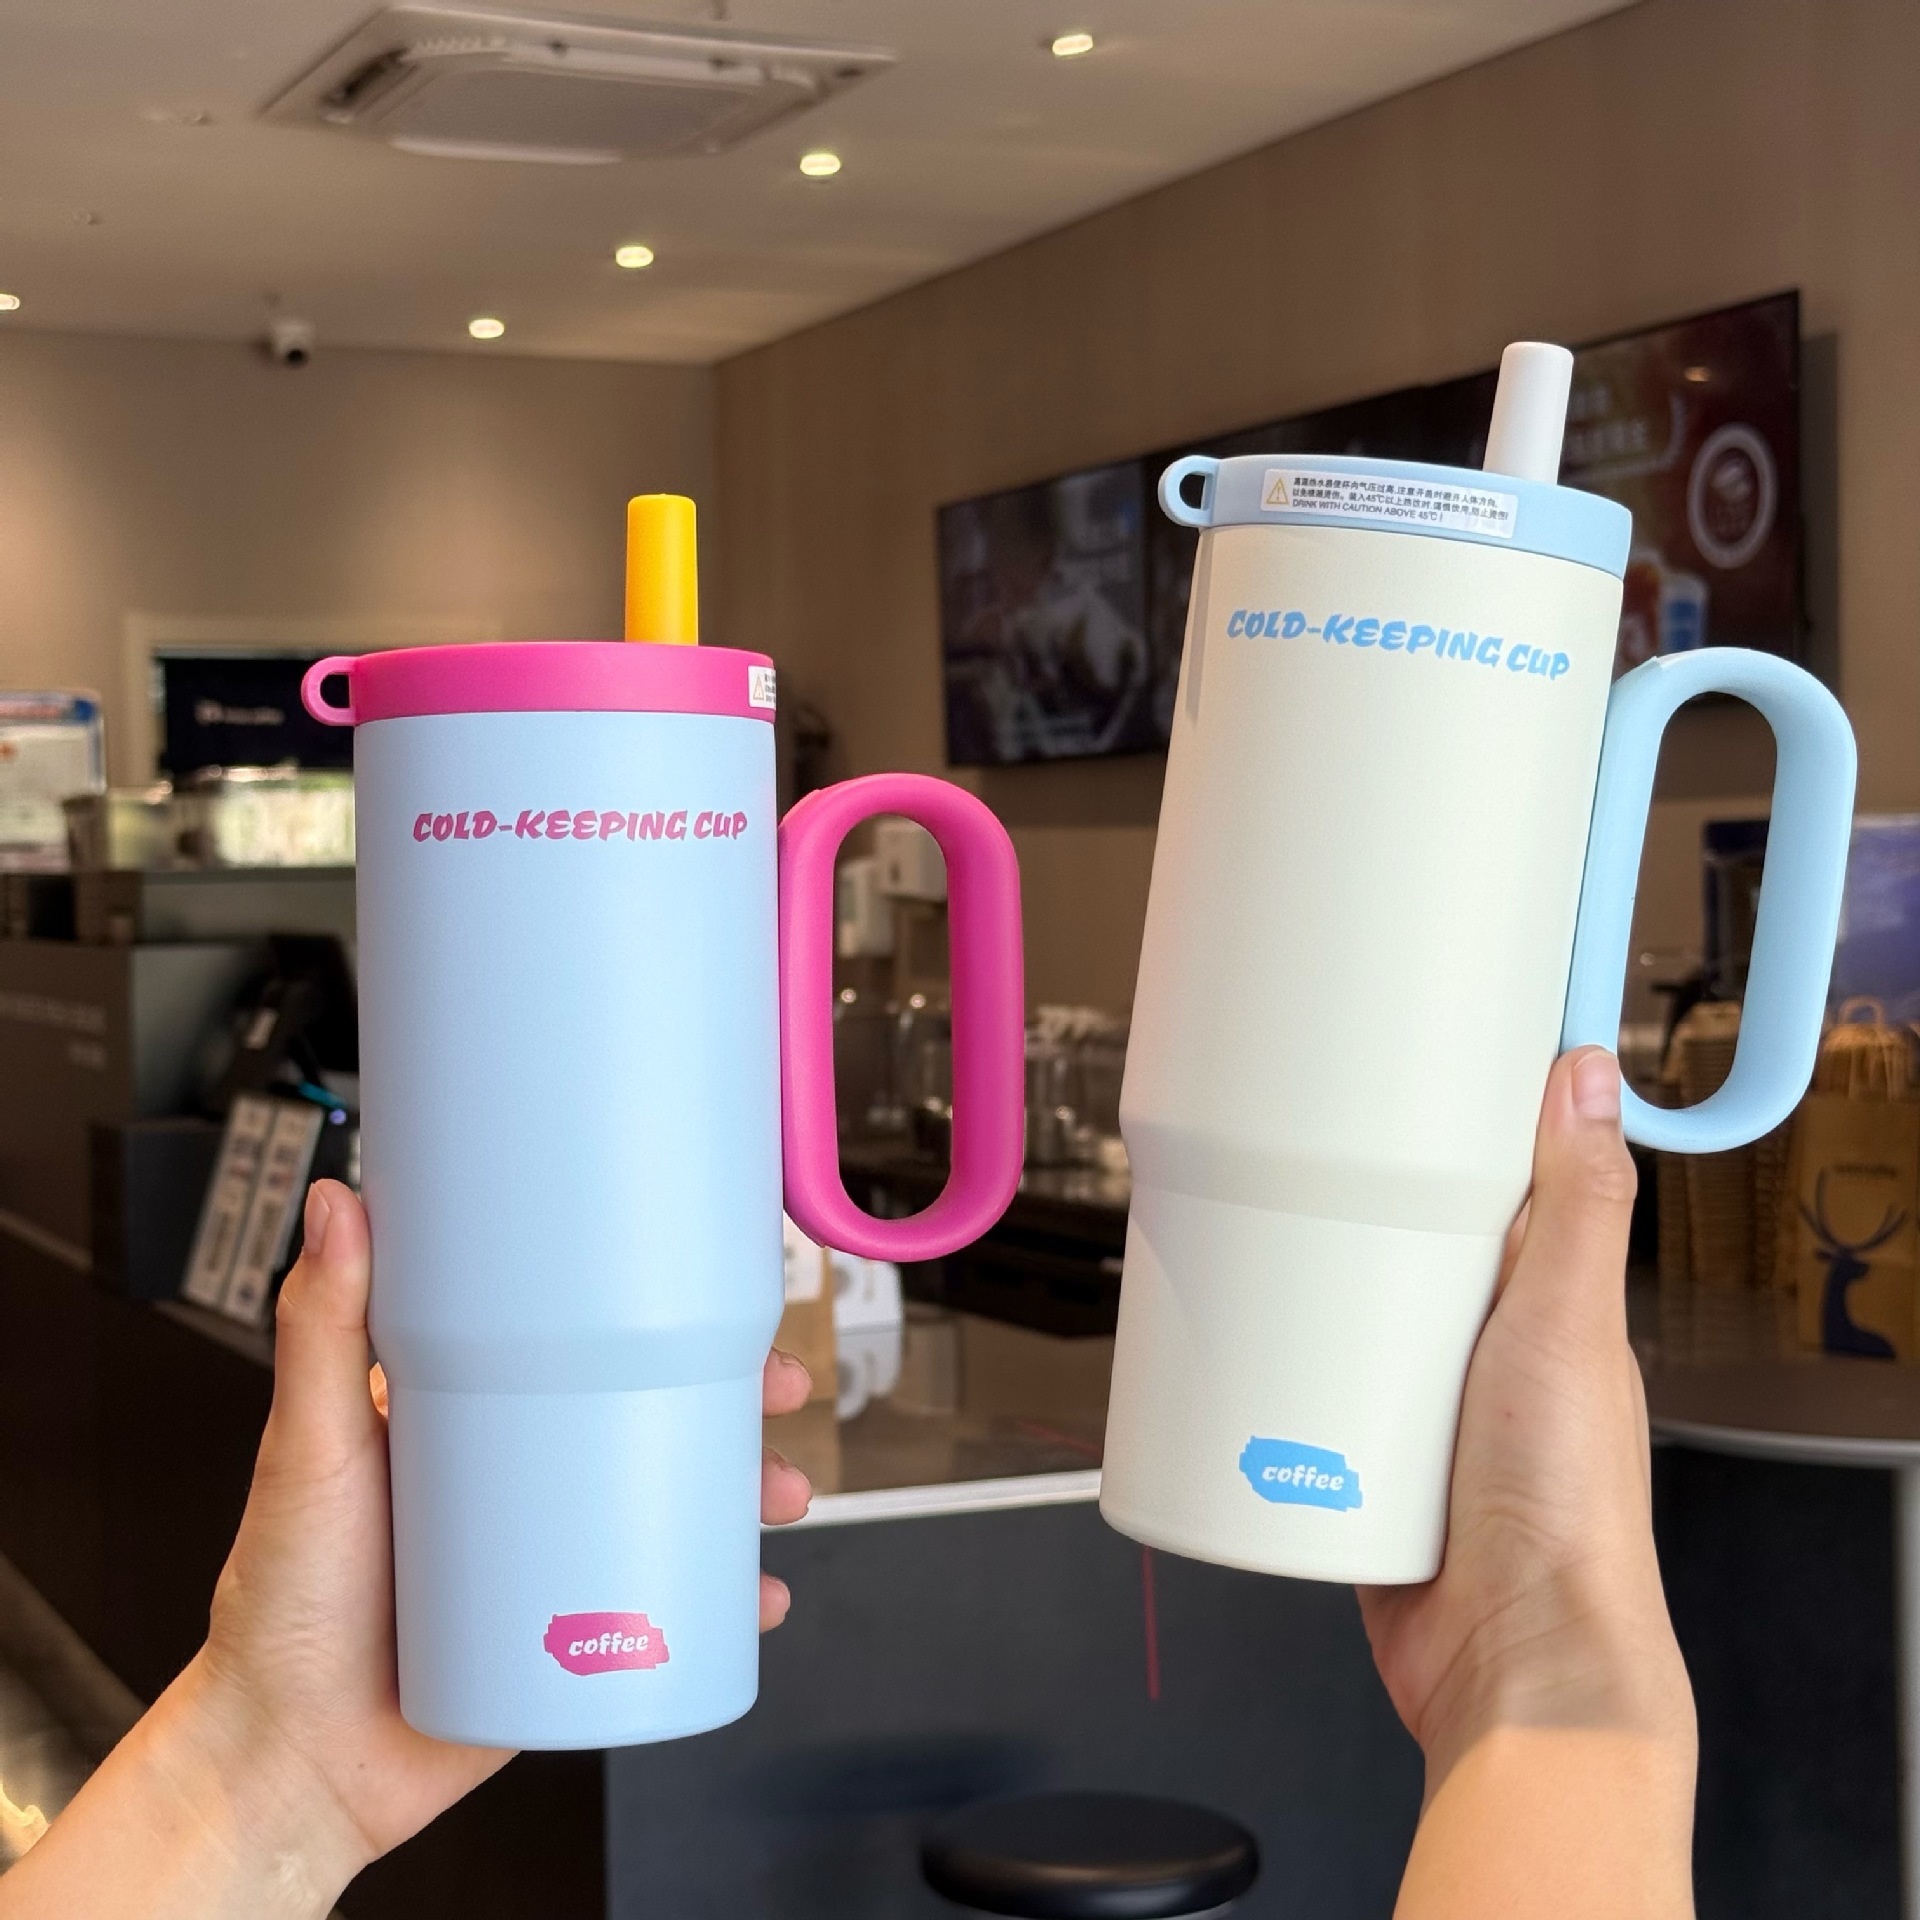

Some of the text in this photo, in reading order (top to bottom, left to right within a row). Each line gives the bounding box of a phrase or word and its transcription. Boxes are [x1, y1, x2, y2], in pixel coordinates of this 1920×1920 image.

[1292, 499, 1317, 509] DRINK
[1319, 500, 1341, 510] WITH
[1342, 502, 1383, 513] CAUTION
[1384, 507, 1416, 519] ABOVE
[1227, 609, 1503, 668] COLD-KEEPING
[413, 809, 688, 842] COLD-KEEPING
[1262, 1464, 1344, 1491] coffee
[568, 1631, 649, 1657] coffee
